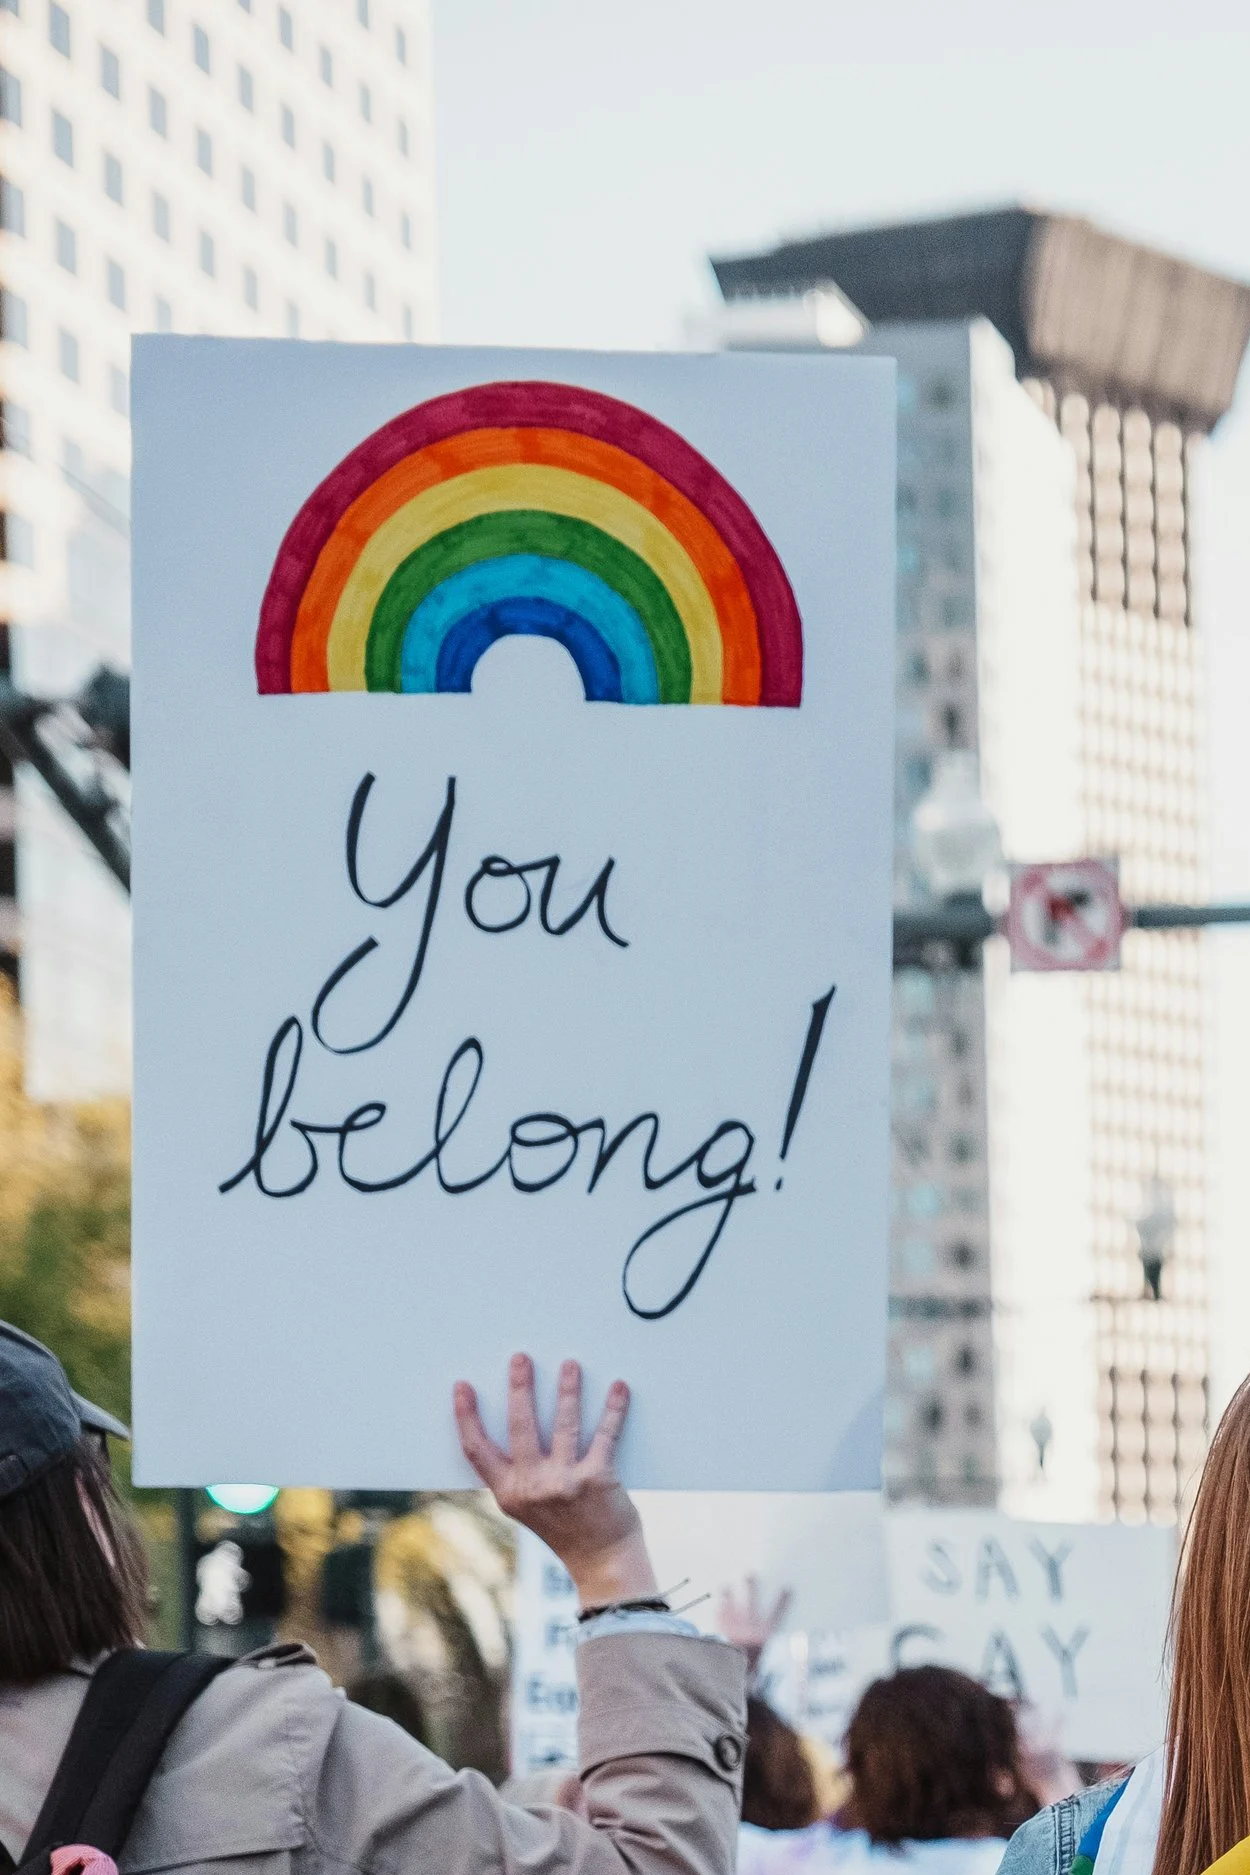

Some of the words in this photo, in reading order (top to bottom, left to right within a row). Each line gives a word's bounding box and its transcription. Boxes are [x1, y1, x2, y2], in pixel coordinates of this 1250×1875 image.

[311, 771, 630, 1055] You
[219, 984, 837, 1319] belong!
[918, 1535, 1076, 1605] SAY
